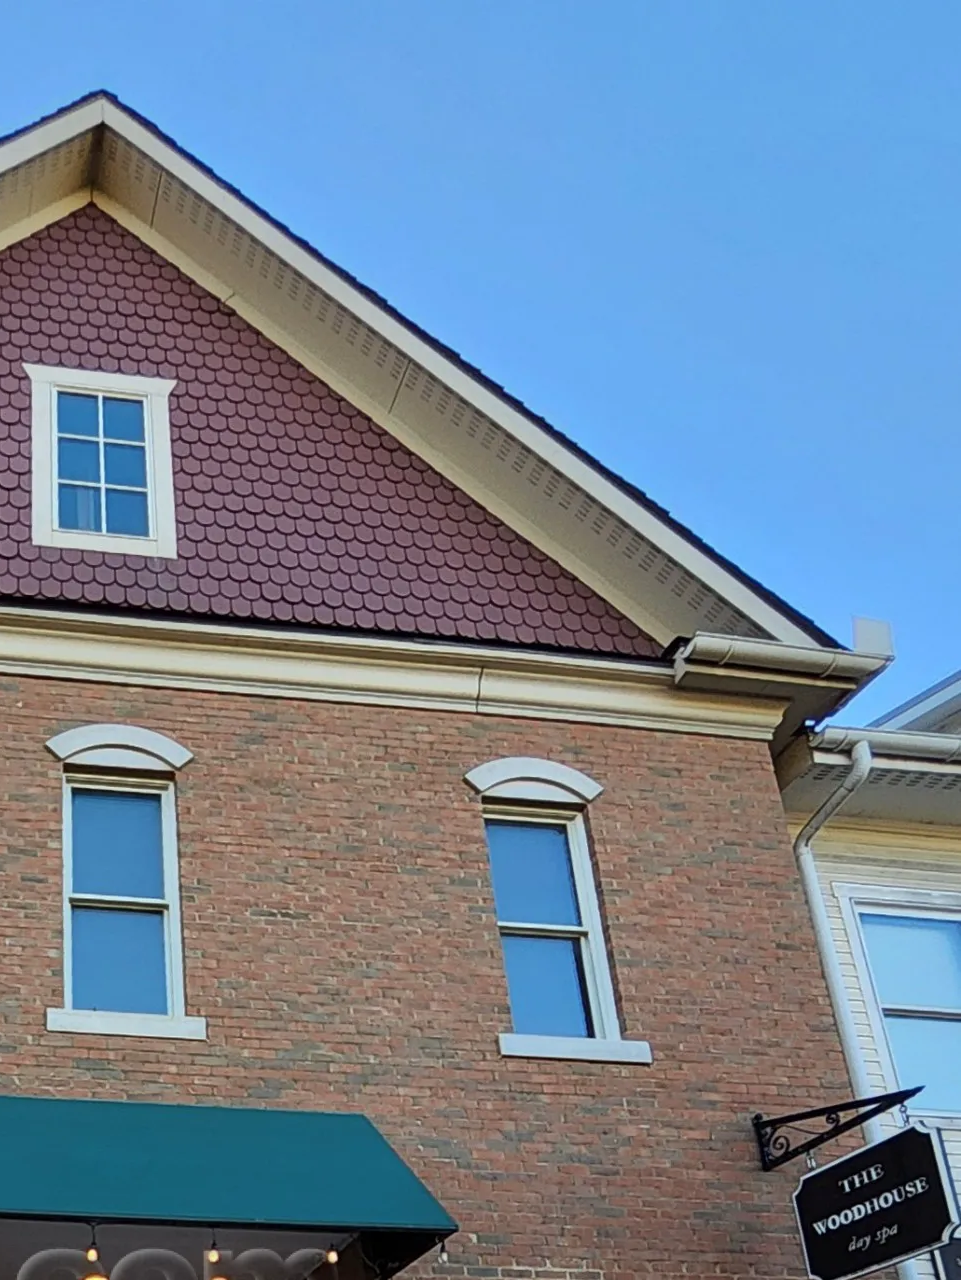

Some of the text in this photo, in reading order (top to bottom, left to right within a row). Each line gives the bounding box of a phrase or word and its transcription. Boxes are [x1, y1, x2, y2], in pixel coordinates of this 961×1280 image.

[839, 1164, 884, 1194] THE
[812, 1177, 930, 1236] WOODHOUSE
[848, 1224, 898, 1252] day spa
